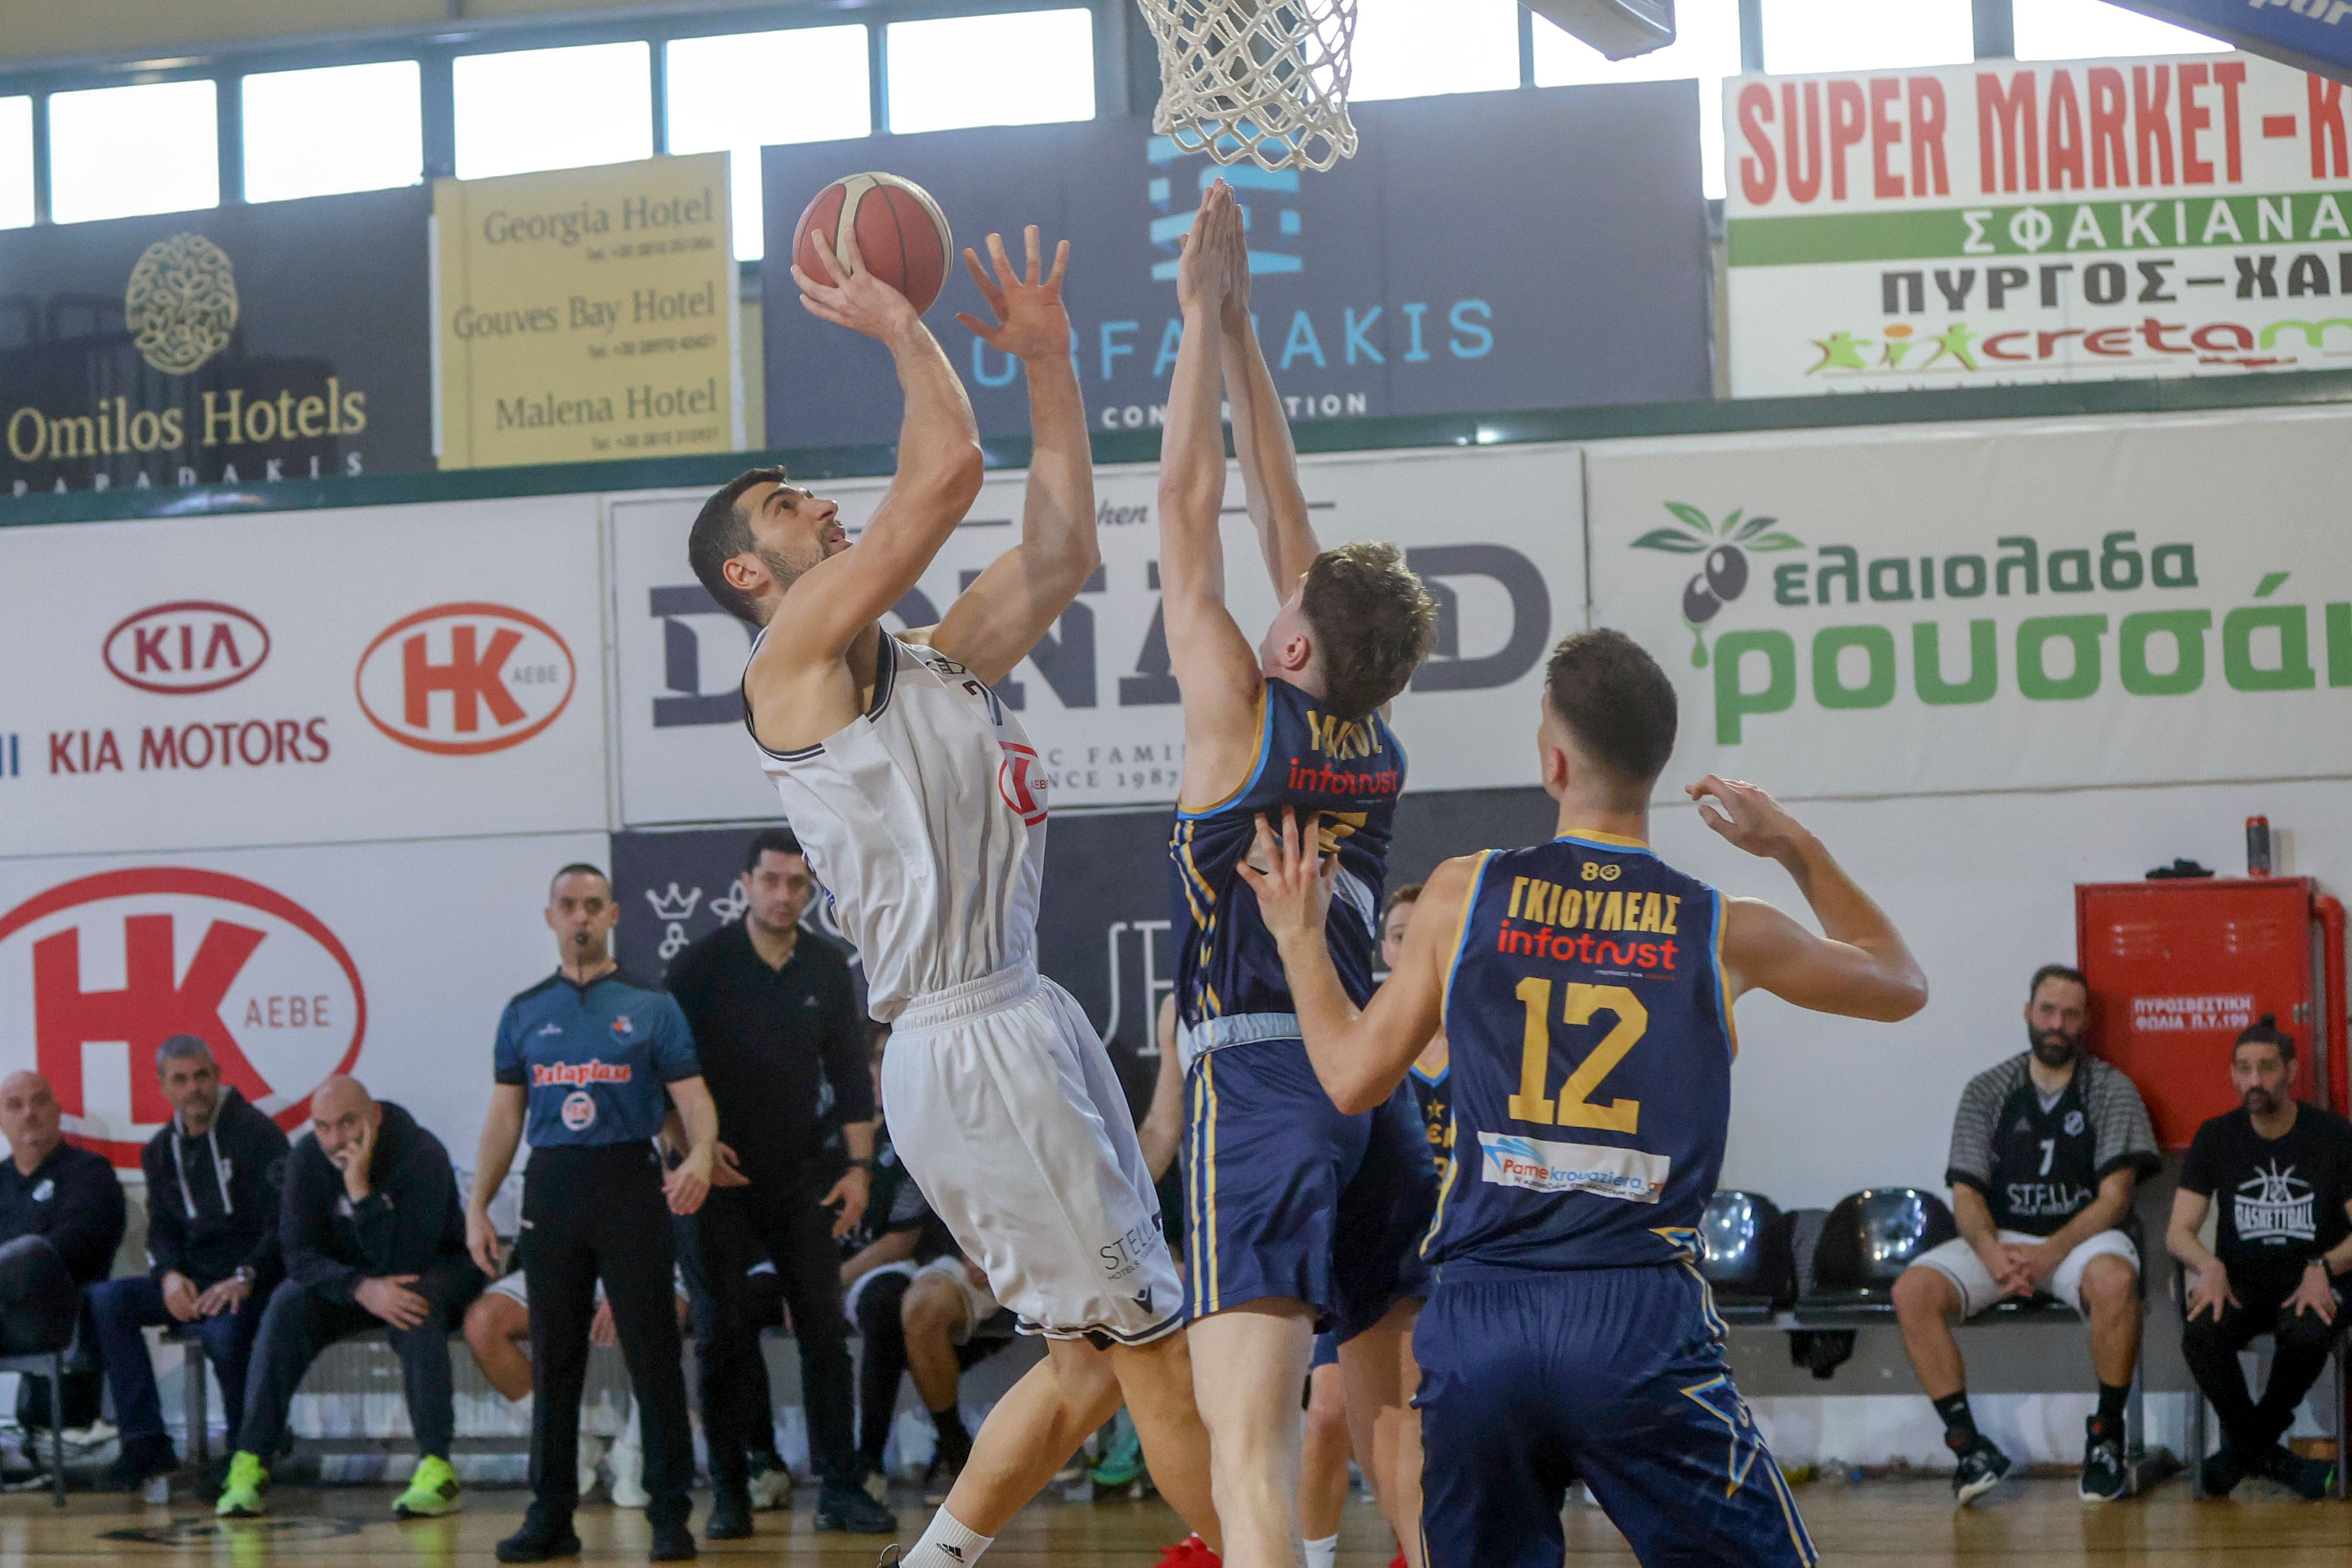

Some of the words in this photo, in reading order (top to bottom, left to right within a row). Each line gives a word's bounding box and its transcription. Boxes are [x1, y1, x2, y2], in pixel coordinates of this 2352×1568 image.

[1737, 76, 1951, 206] SUPER
[484, 200, 609, 246] Georgia
[623, 189, 713, 230] Hotel
[453, 305, 559, 342] Gouves
[569, 296, 622, 333] Bay
[633, 281, 715, 323] Hotel
[972, 300, 1494, 387] OFAAKIS
[8, 398, 183, 461] Omilos
[203, 378, 367, 445] Hotels
[496, 393, 613, 433] Malena
[626, 378, 716, 420] Hotel
[403, 625, 528, 733] HK
[49, 729, 124, 774] KIA
[139, 718, 331, 771] MOTORS
[1087, 742, 1187, 765] FAMI
[1117, 767, 1178, 789] 1987
[1289, 757, 1399, 795] infotrust
[1507, 876, 1682, 935] ΓΚΙΟΥΛΕΑΣ
[1498, 919, 1680, 971] infotrust
[33, 913, 274, 1125] HK
[1509, 977, 1649, 1135] 12
